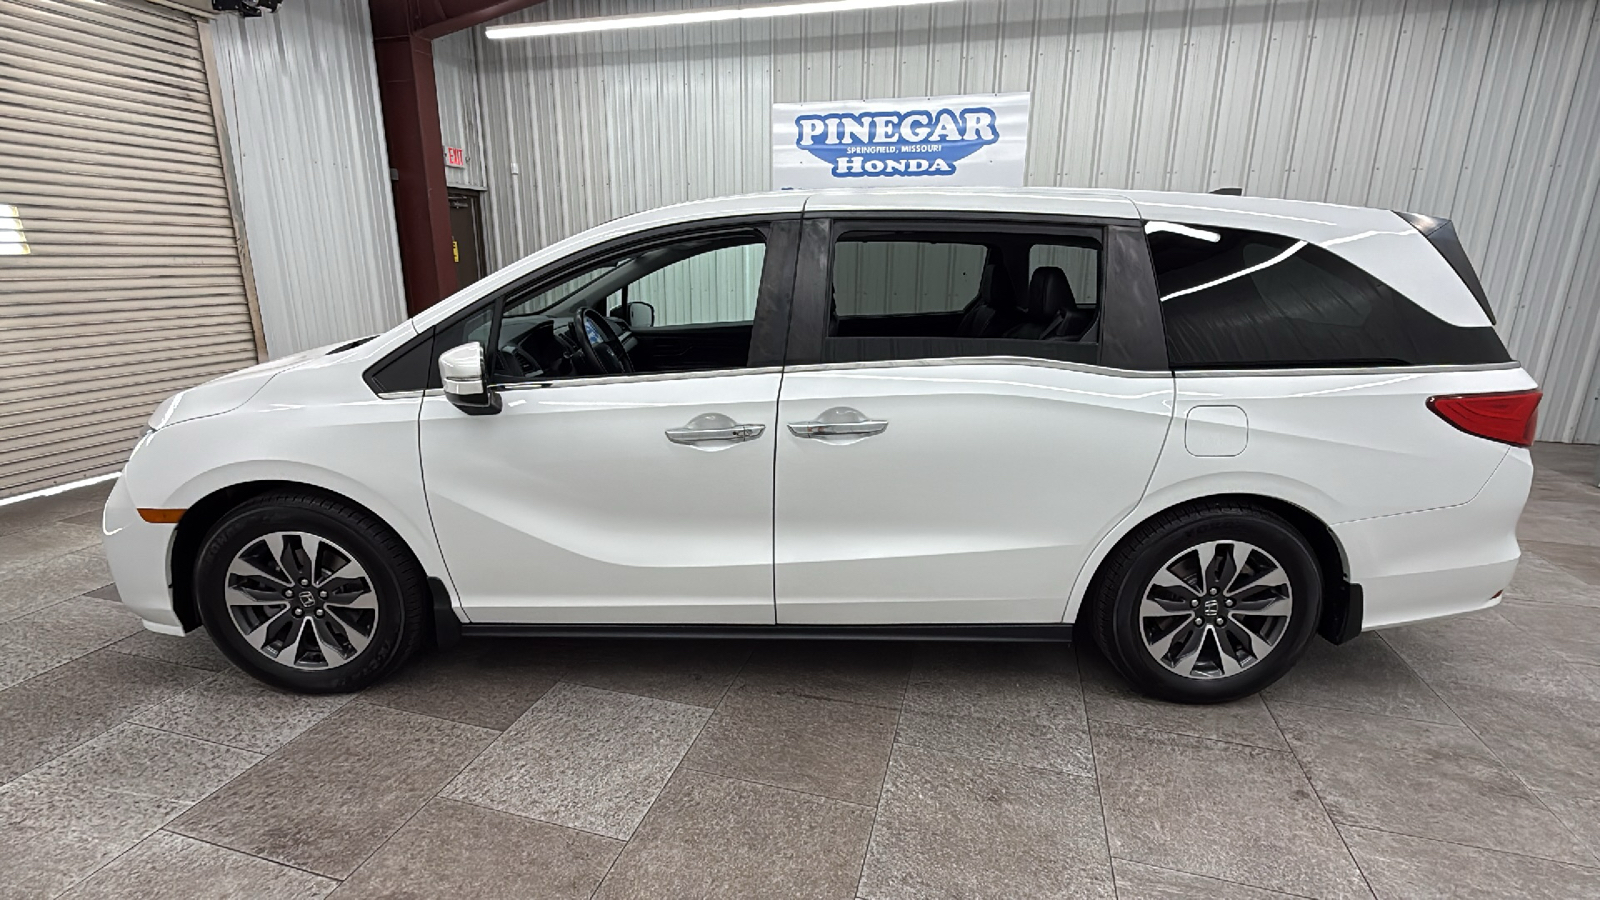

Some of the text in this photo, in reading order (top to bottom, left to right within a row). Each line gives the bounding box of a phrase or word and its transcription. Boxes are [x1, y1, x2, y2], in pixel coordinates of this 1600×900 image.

[799, 112, 994, 145] PINEGAR
[448, 147, 463, 165] EXIT
[846, 144, 942, 154] SPRINGFIELD, MISSOURI
[836, 156, 952, 173] HONDA
